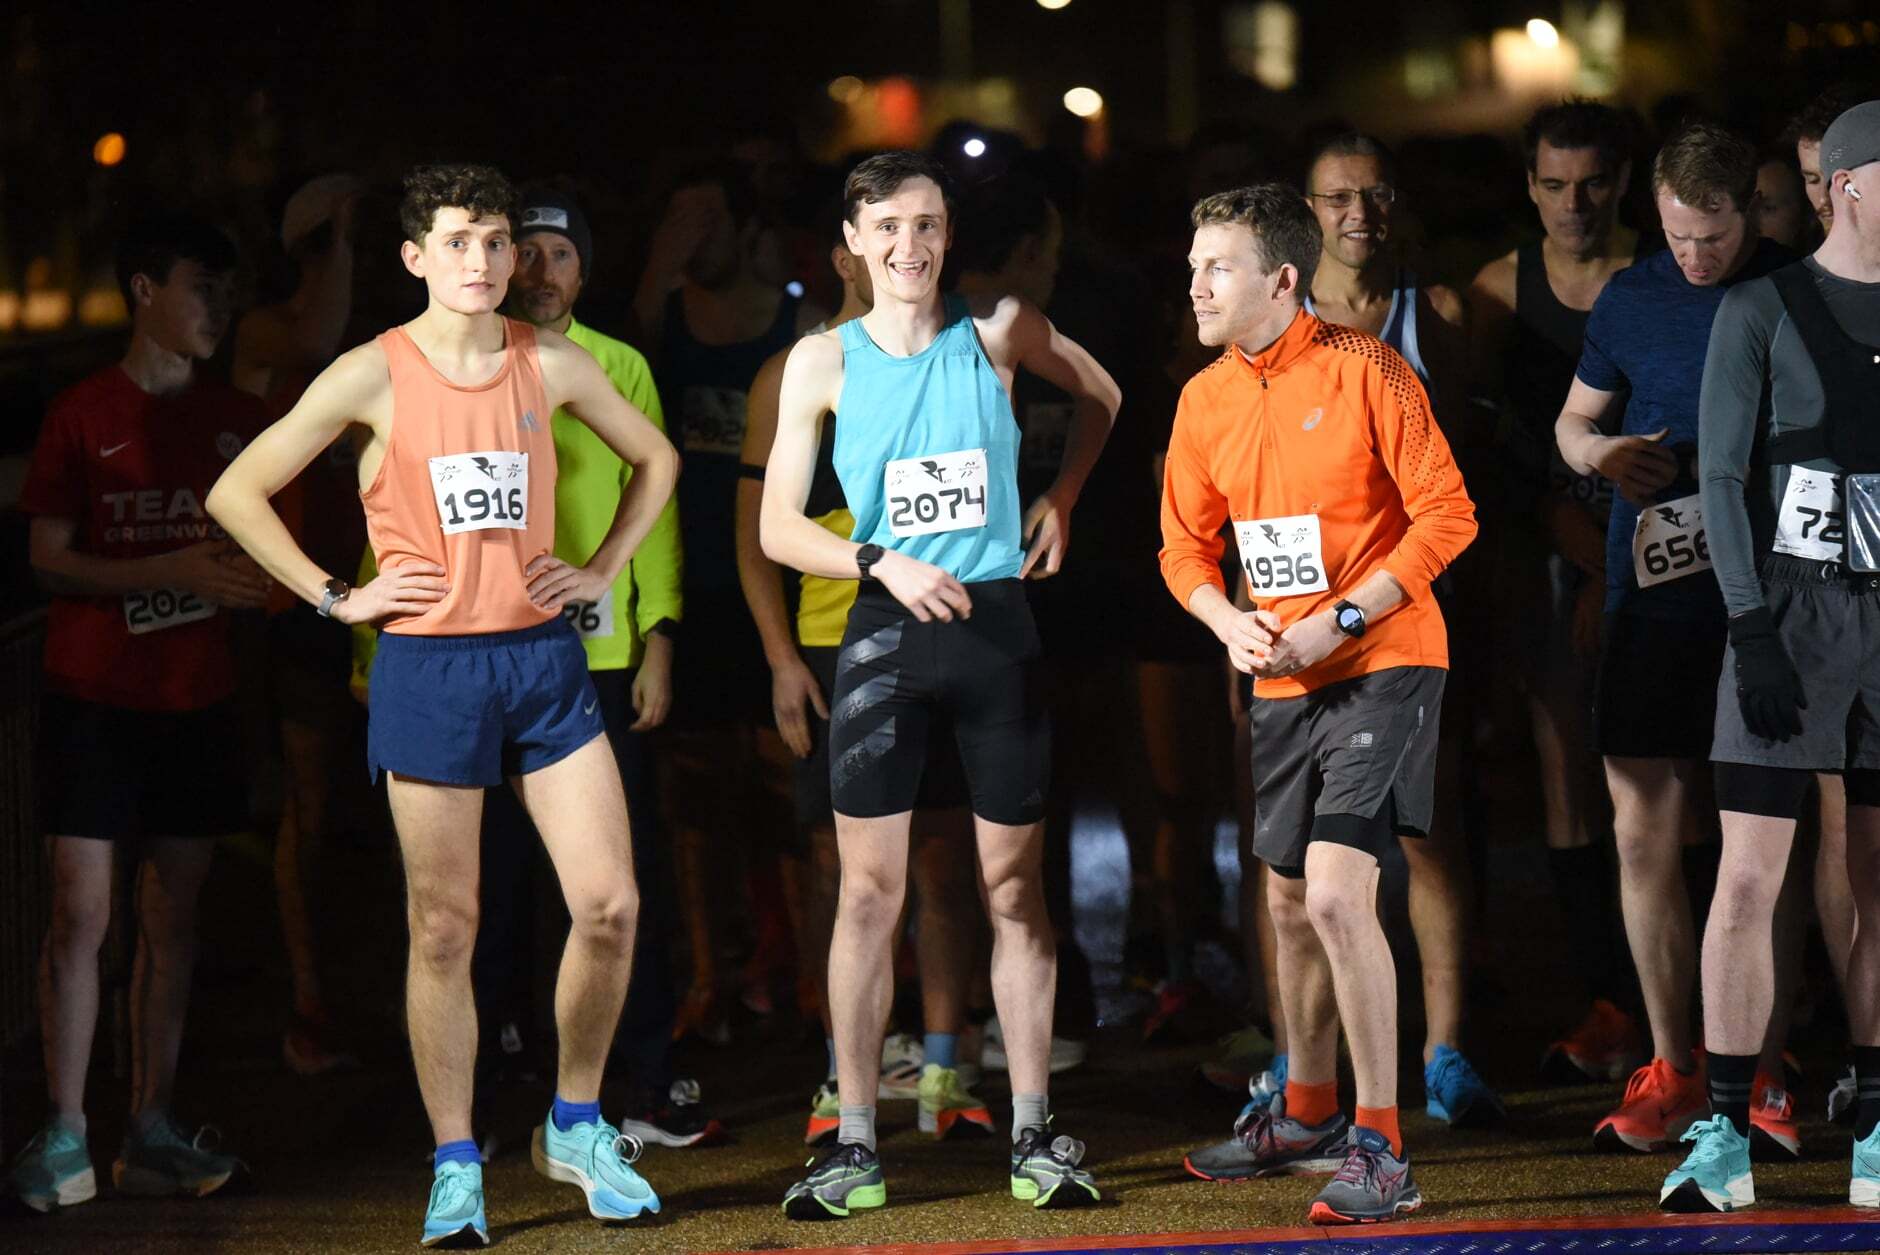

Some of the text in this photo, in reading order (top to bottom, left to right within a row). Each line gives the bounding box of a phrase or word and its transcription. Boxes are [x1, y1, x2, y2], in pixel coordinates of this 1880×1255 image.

[101, 487, 210, 522] TEA
[444, 487, 523, 525] 1916
[890, 485, 985, 527] 2074
[1245, 552, 1320, 589] 1936
